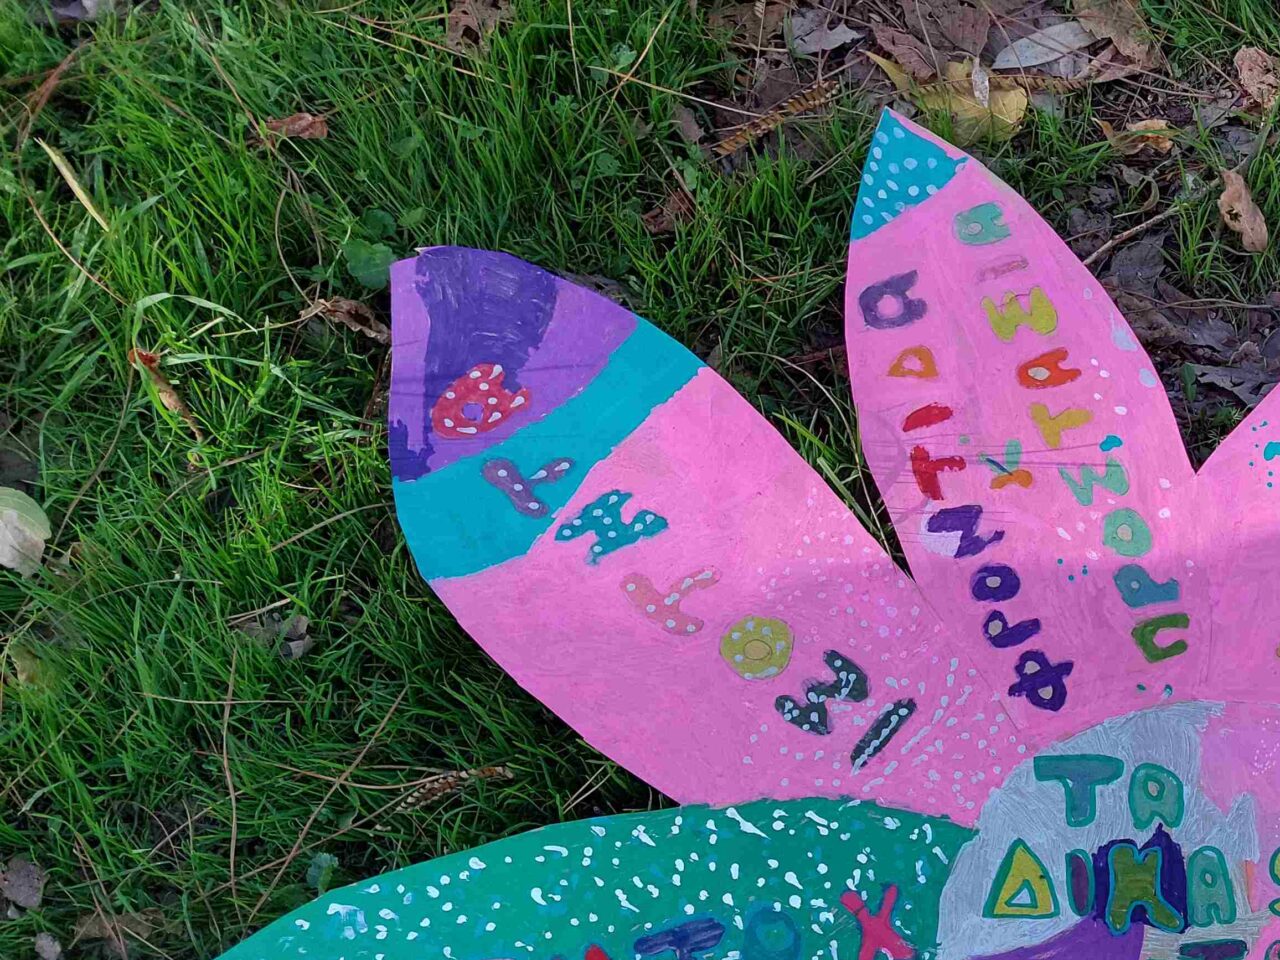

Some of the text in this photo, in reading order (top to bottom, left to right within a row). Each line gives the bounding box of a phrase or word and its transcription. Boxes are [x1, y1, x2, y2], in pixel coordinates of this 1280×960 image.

[430, 363, 917, 776] ΙΣΟΤΗΤΑ
[953, 201, 1190, 663] ΠΡΟΣΤΑΣΙΑ
[1033, 754, 1185, 828] ΤΑ
